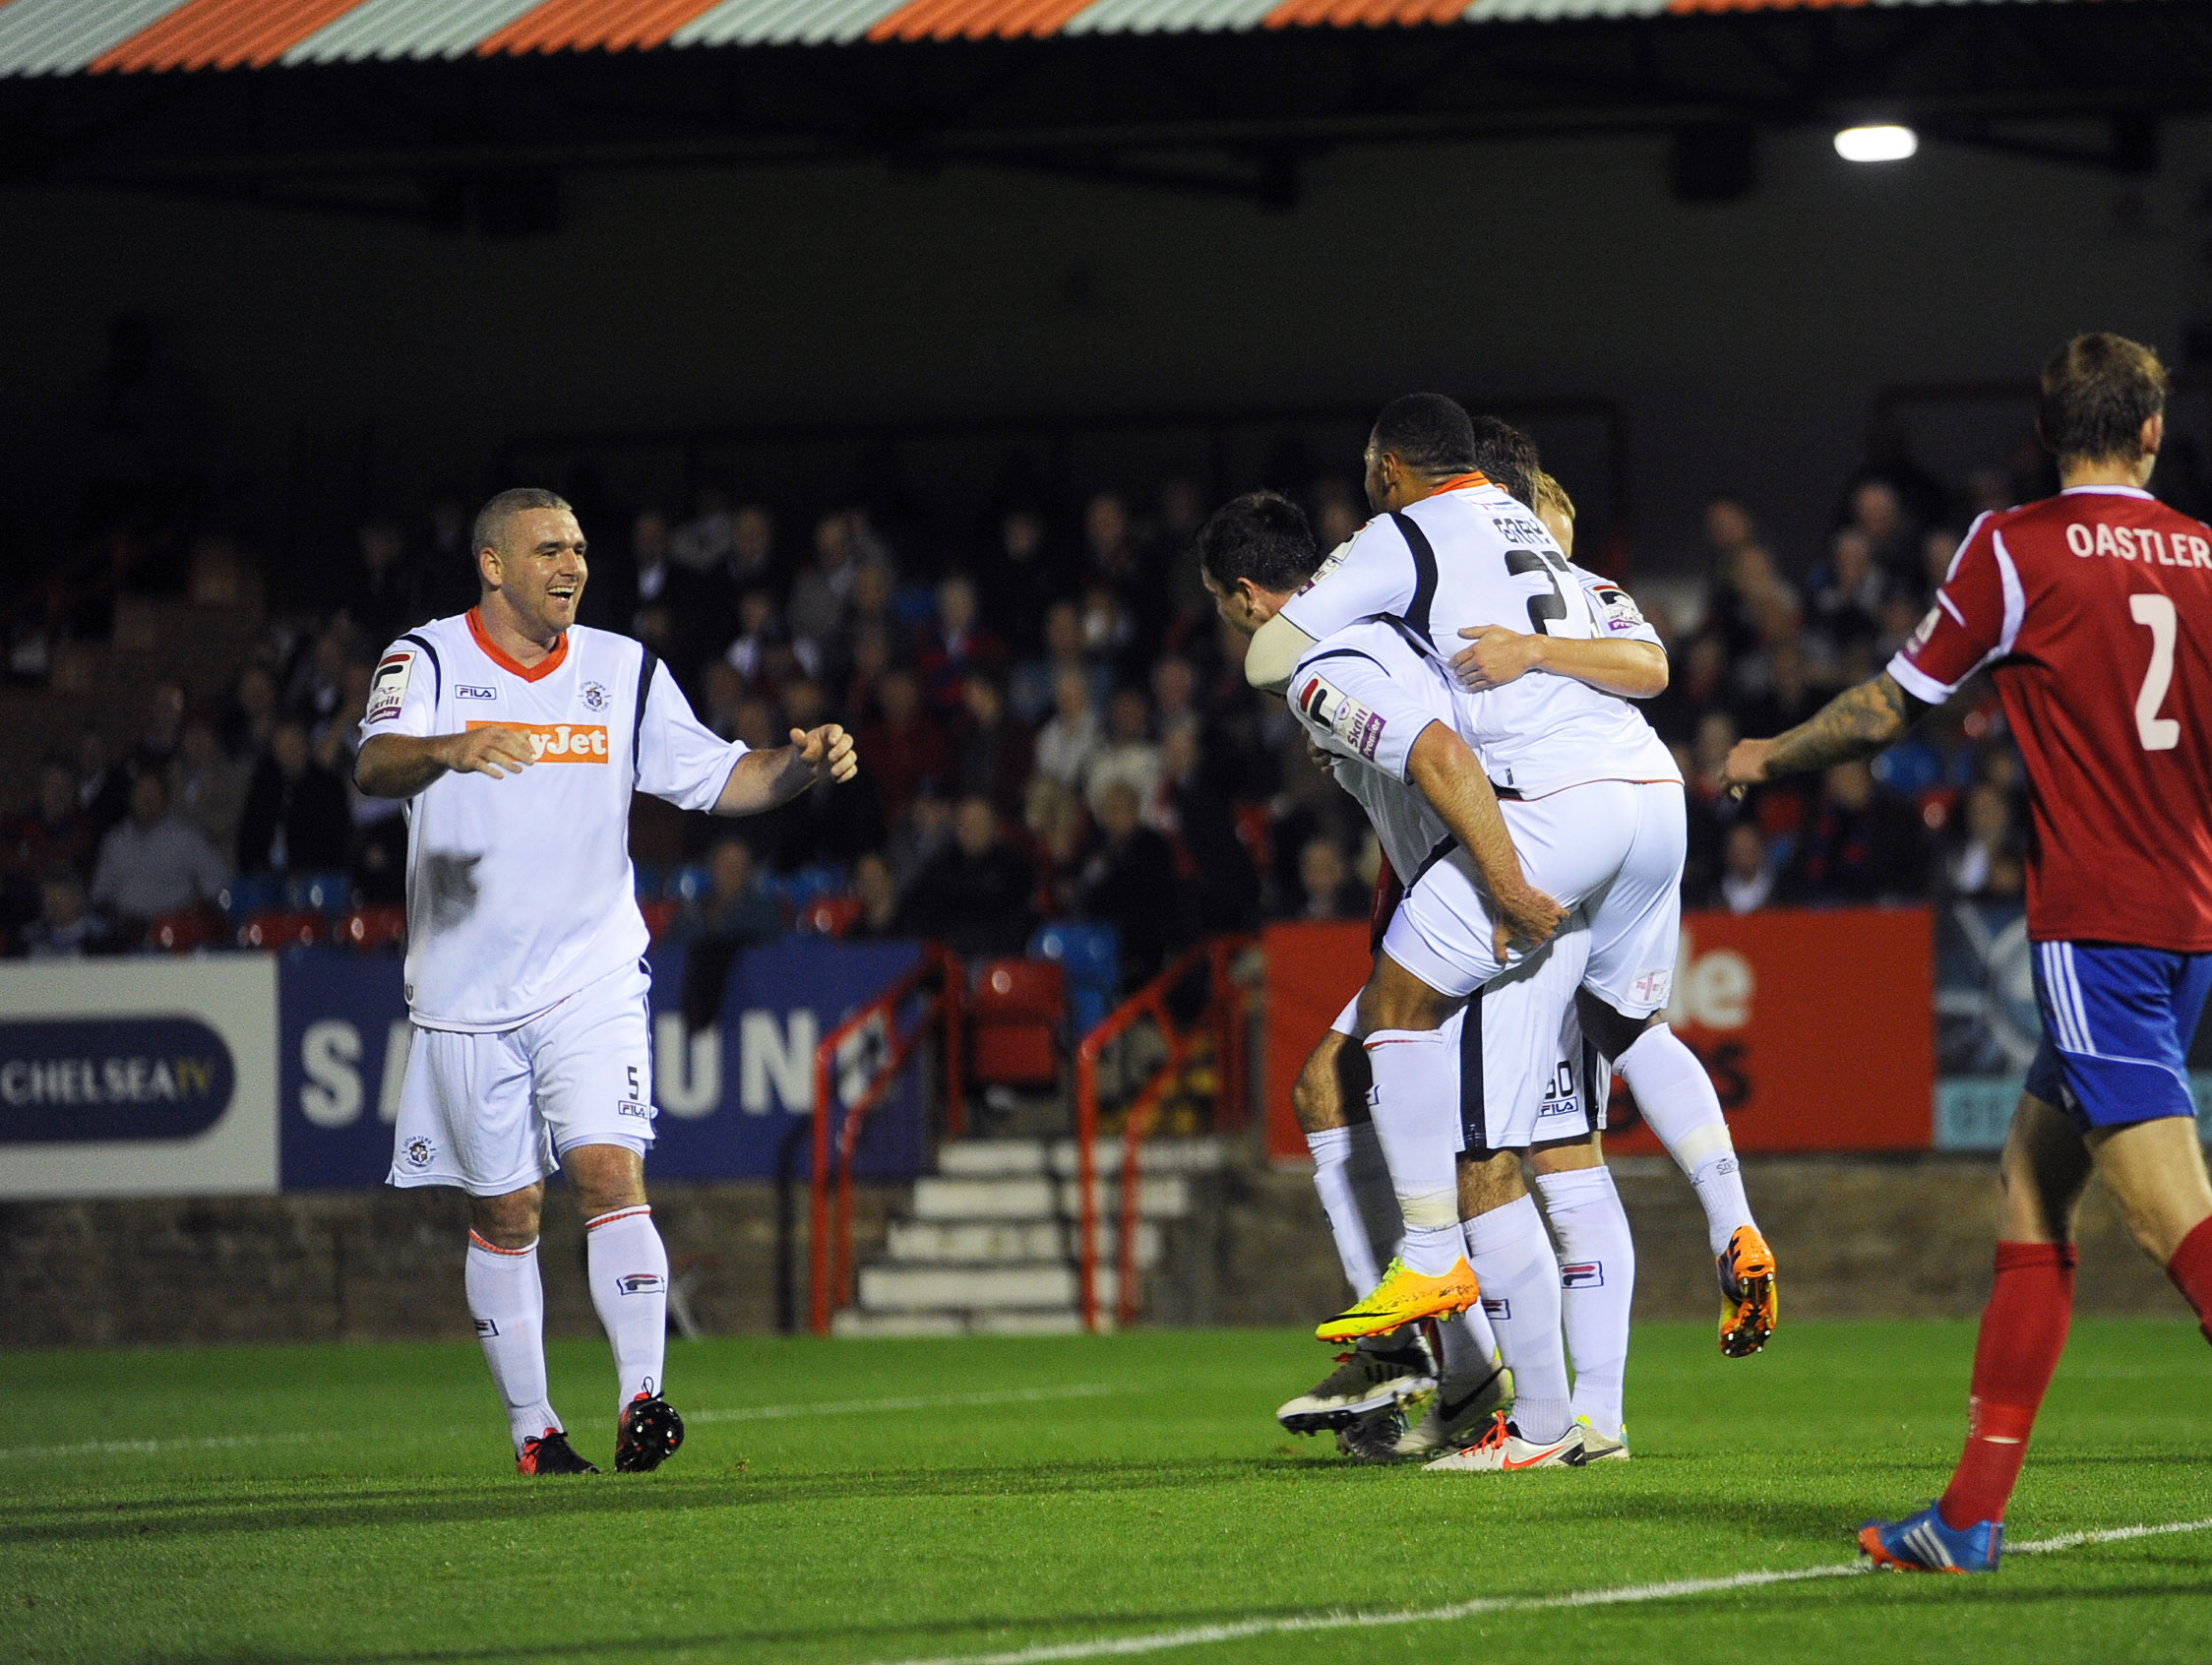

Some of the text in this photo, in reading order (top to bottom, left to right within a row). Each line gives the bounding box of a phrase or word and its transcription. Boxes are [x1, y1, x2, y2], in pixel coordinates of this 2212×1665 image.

[2065, 522, 2212, 570] OASTLER
[2128, 592, 2181, 751] 2
[459, 686, 493, 699] FILA
[528, 725, 607, 761] yJet
[1346, 708, 1369, 749] Skrill
[627, 1065, 640, 1101] 5
[622, 1103, 645, 1118] FILA
[1540, 1100, 1574, 1115] FILA
